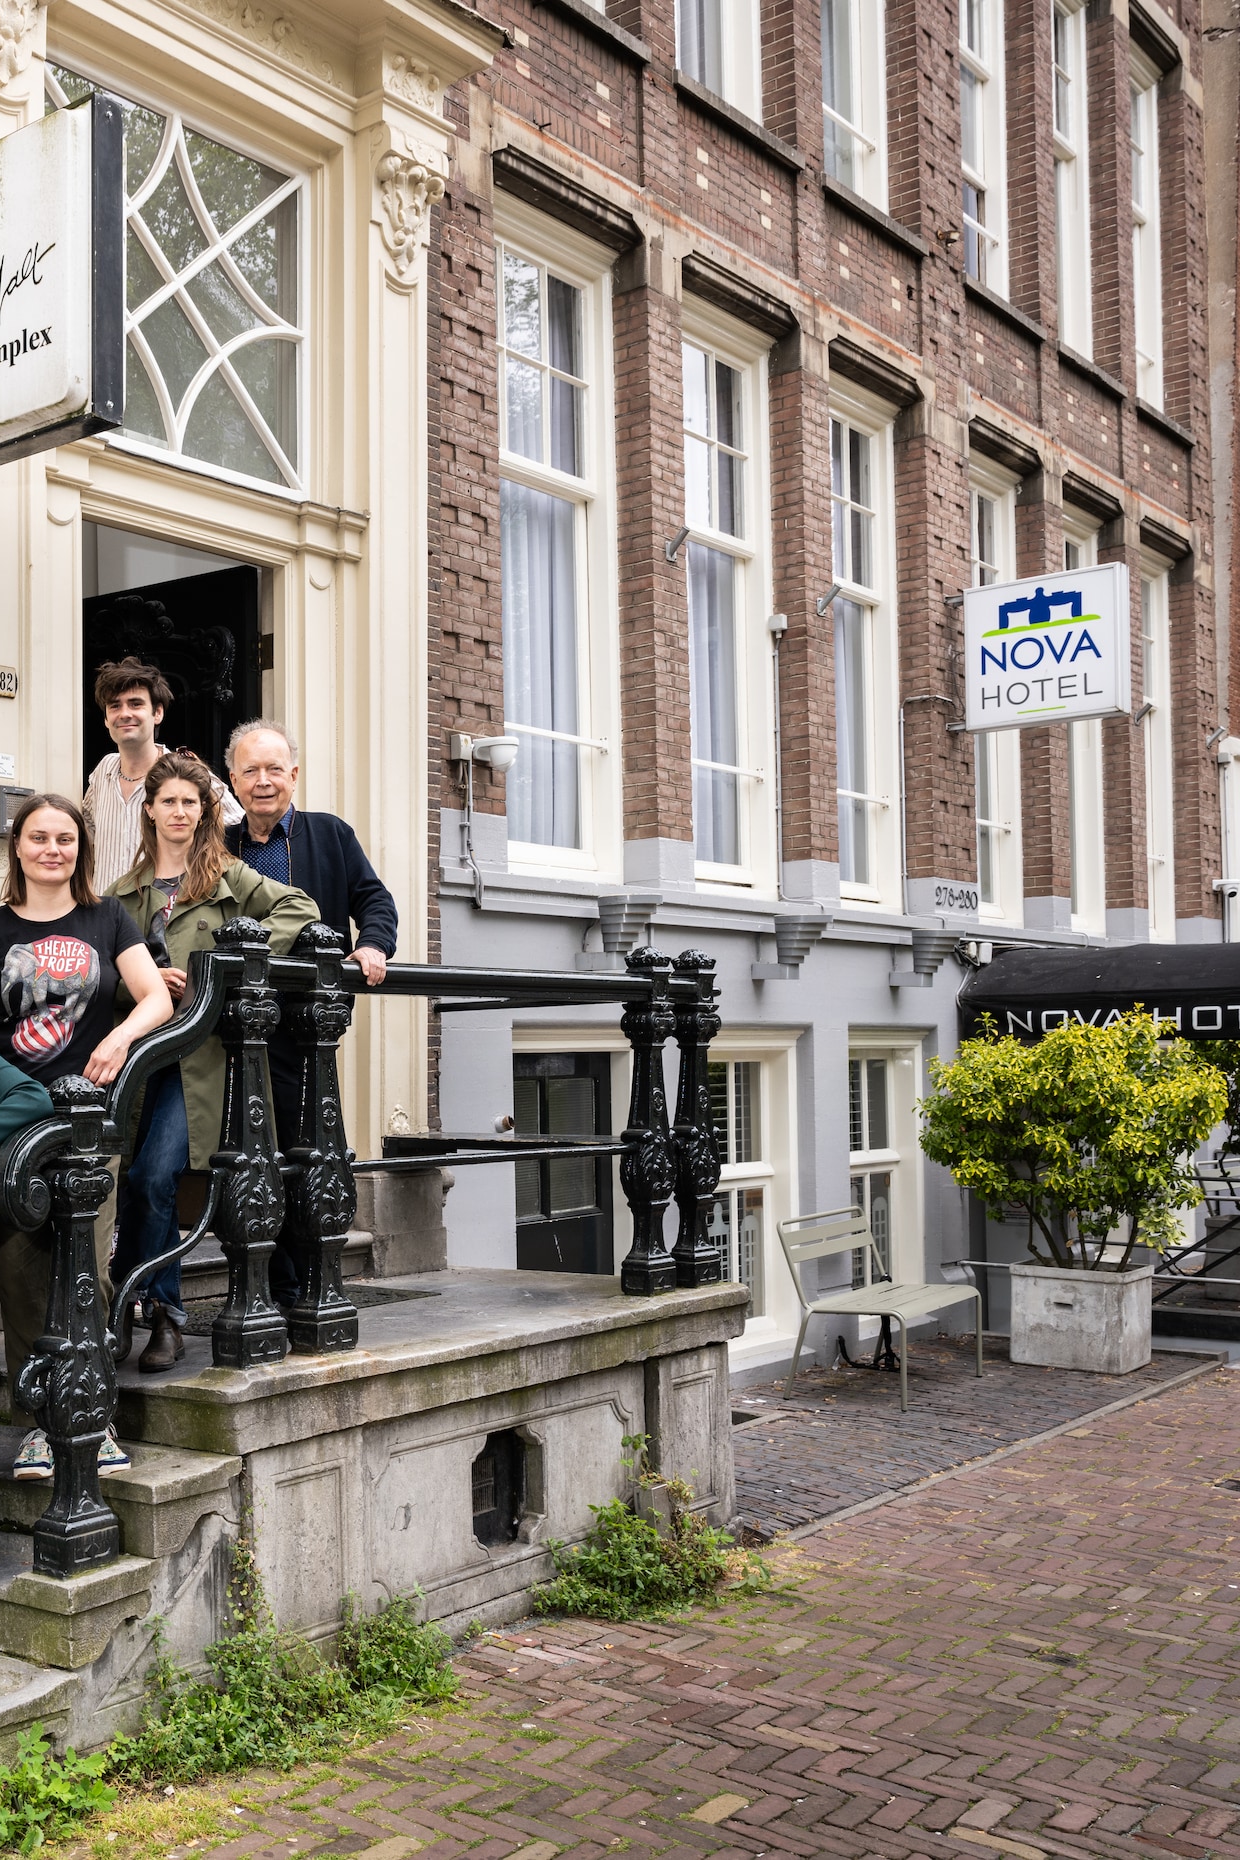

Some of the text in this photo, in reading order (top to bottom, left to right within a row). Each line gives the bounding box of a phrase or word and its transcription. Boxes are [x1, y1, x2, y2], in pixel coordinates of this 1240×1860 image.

[981, 629, 1102, 676] NOVA
[981, 672, 1103, 710] HOTEL
[935, 886, 978, 910] 278-280
[35, 940, 89, 959] THEATER-
[38, 954, 86, 973] TROEP
[1006, 1008, 1128, 1034] NOVA
